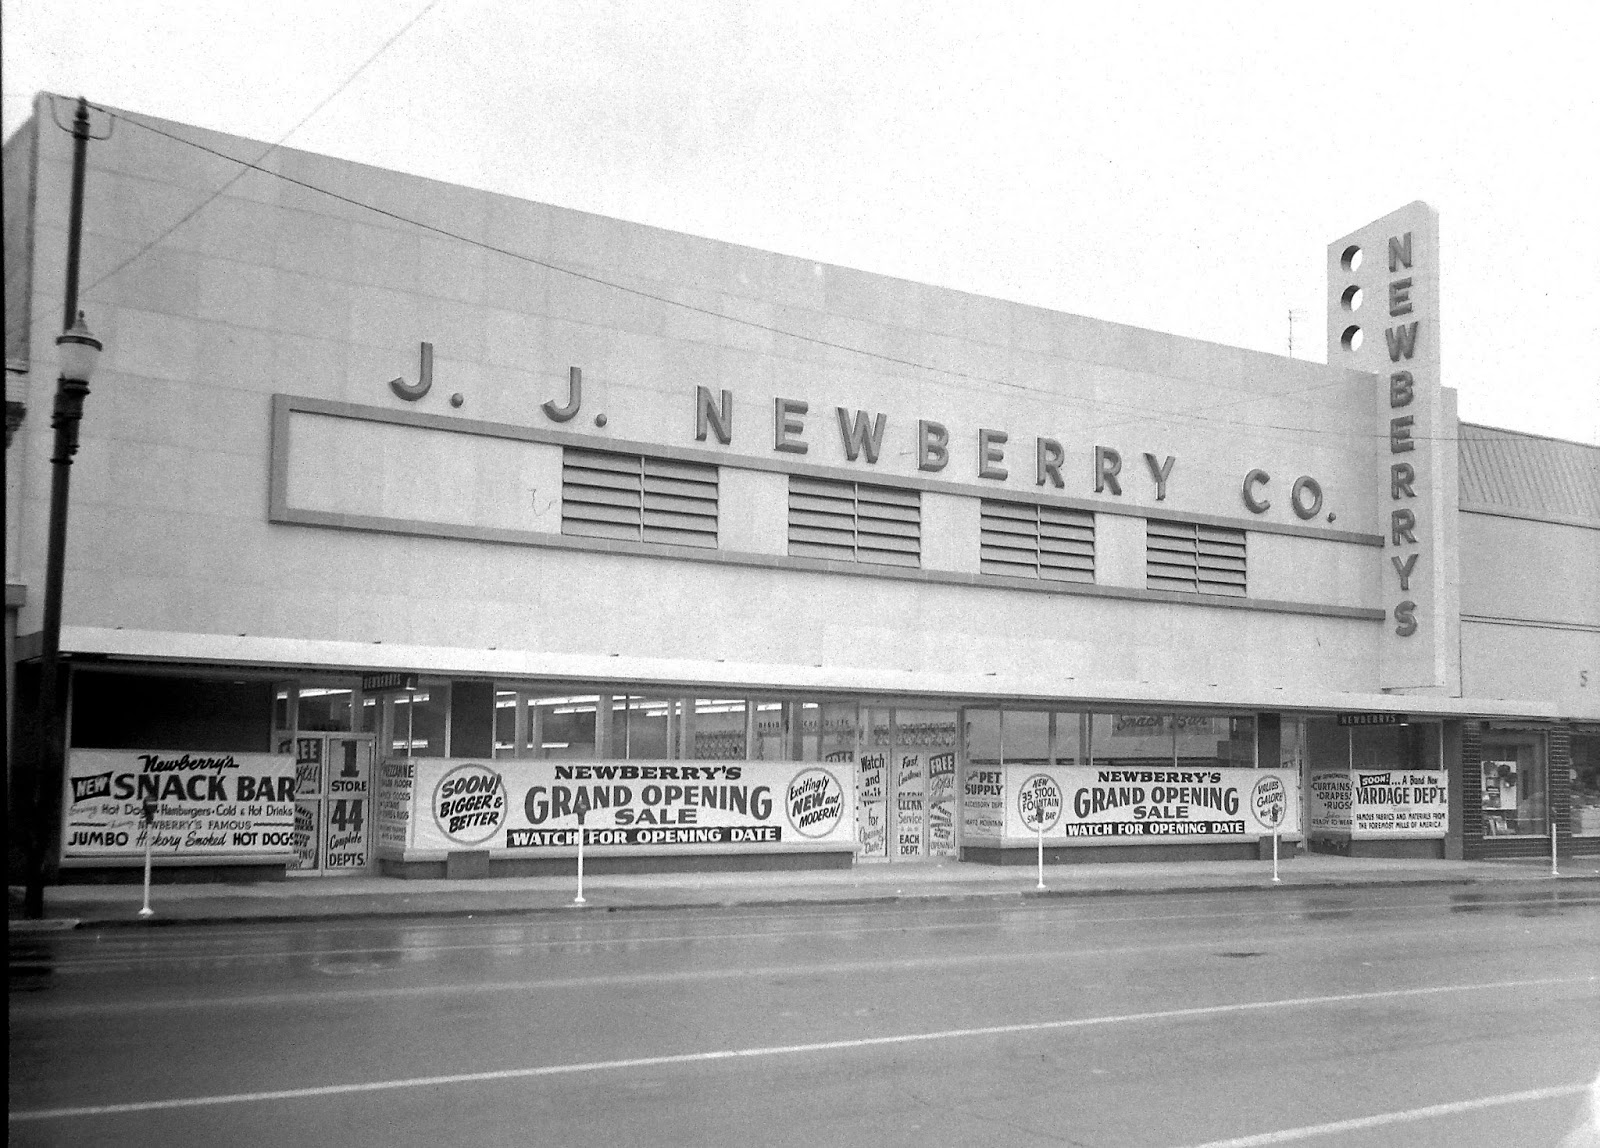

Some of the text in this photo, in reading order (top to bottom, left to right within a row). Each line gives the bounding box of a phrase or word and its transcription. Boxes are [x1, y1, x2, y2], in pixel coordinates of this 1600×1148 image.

[390, 342, 1336, 523] J. J. NEWBERRY CO.
[1385, 232, 1418, 638] NEWBERRYS
[138, 754, 239, 775] Newberry's
[341, 740, 359, 778] 1
[861, 754, 885, 773] Watch
[930, 756, 954, 775] FREE
[554, 765, 742, 780] NEWBERRY'S
[865, 770, 880, 787] and
[979, 772, 1002, 783] PET
[1098, 771, 1221, 783] NEWBERRY'S
[1362, 773, 1390, 786] SOON!
[77, 773, 295, 802] NEW SNACK BAR
[331, 780, 367, 792] STORE
[441, 773, 502, 799] SOON!
[790, 775, 830, 801] Excitingly
[964, 784, 1003, 796] SUPPLY
[1032, 778, 1049, 789] NEW
[1258, 781, 1279, 795] VALUES
[1034, 787, 1057, 799] STOOL
[1256, 792, 1284, 808] GALORE
[1356, 787, 1410, 804] YARDAGE
[102, 804, 120, 816] Hot
[249, 805, 262, 816] Hot
[266, 805, 293, 816] Drinks
[440, 795, 503, 818] BIGGER &
[524, 785, 773, 825] GRAND OPENING
[792, 791, 841, 817] NEW and
[1022, 798, 1060, 813] FOUNTAIN
[1074, 787, 1145, 818] GRAND
[1151, 786, 1239, 816] OPENING
[331, 799, 364, 832] 44
[614, 808, 698, 825] SALE
[798, 803, 841, 829] MODERN!
[868, 808, 879, 826] for
[899, 812, 922, 824] Service
[1045, 812, 1057, 821] BAR
[1133, 806, 1189, 819] SALE
[138, 820, 202, 830] NWBERRY'S
[208, 820, 251, 830] FAMOUS
[448, 811, 499, 833] BETTER
[1068, 822, 1244, 836] WATCH FOR OPENING DATE
[68, 832, 129, 846] JUMBO
[185, 831, 227, 847] Smoked
[233, 832, 258, 846] HOT
[330, 832, 362, 850] Complete
[512, 828, 777, 846] WATCH FOR OPENING DATE
[900, 834, 920, 844] EACH
[901, 845, 920, 855] DEPT.
[329, 853, 366, 867] DEPTS.
